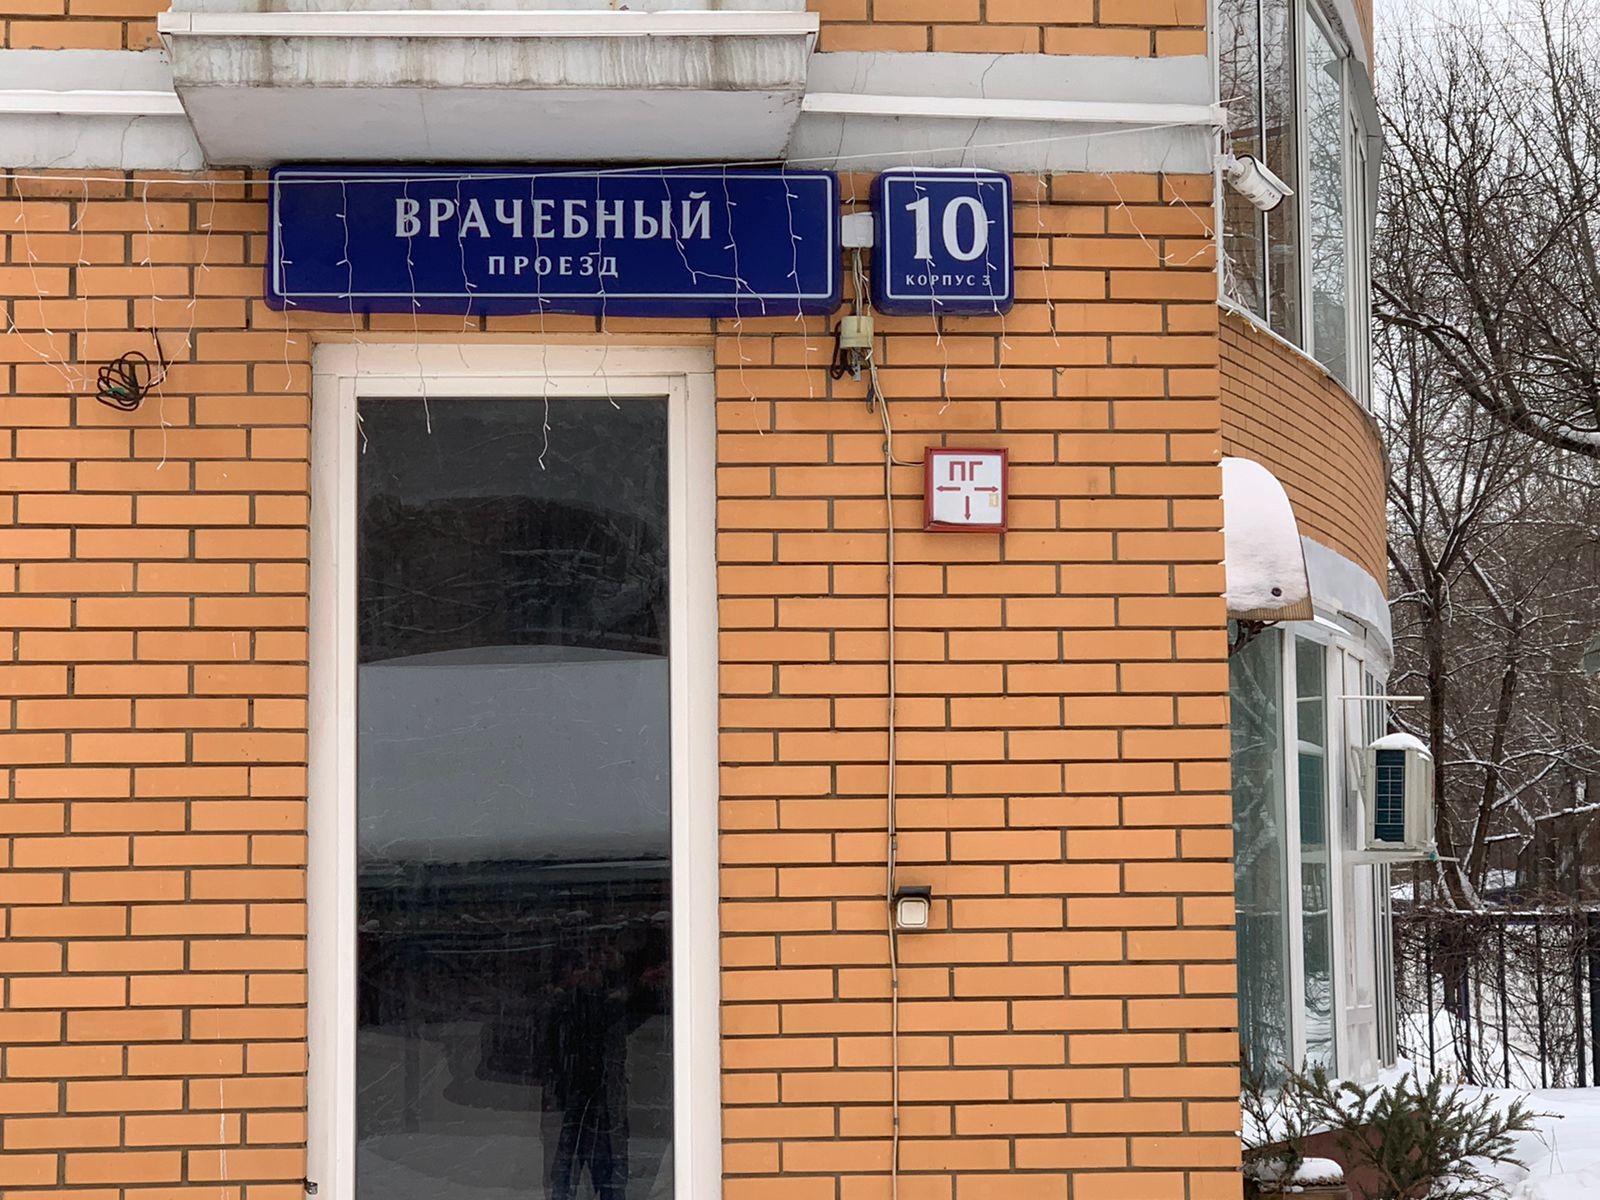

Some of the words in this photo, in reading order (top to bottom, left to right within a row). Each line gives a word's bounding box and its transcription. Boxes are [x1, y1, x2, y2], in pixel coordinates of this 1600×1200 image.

[394, 190, 711, 240] ВРАЧЕБНЫЙ
[905, 196, 989, 261] 10
[488, 255, 619, 277] ПРОЕЗД
[905, 274, 976, 286] КОРПУС
[982, 274, 991, 286] 3
[949, 460, 984, 482] ПГ
